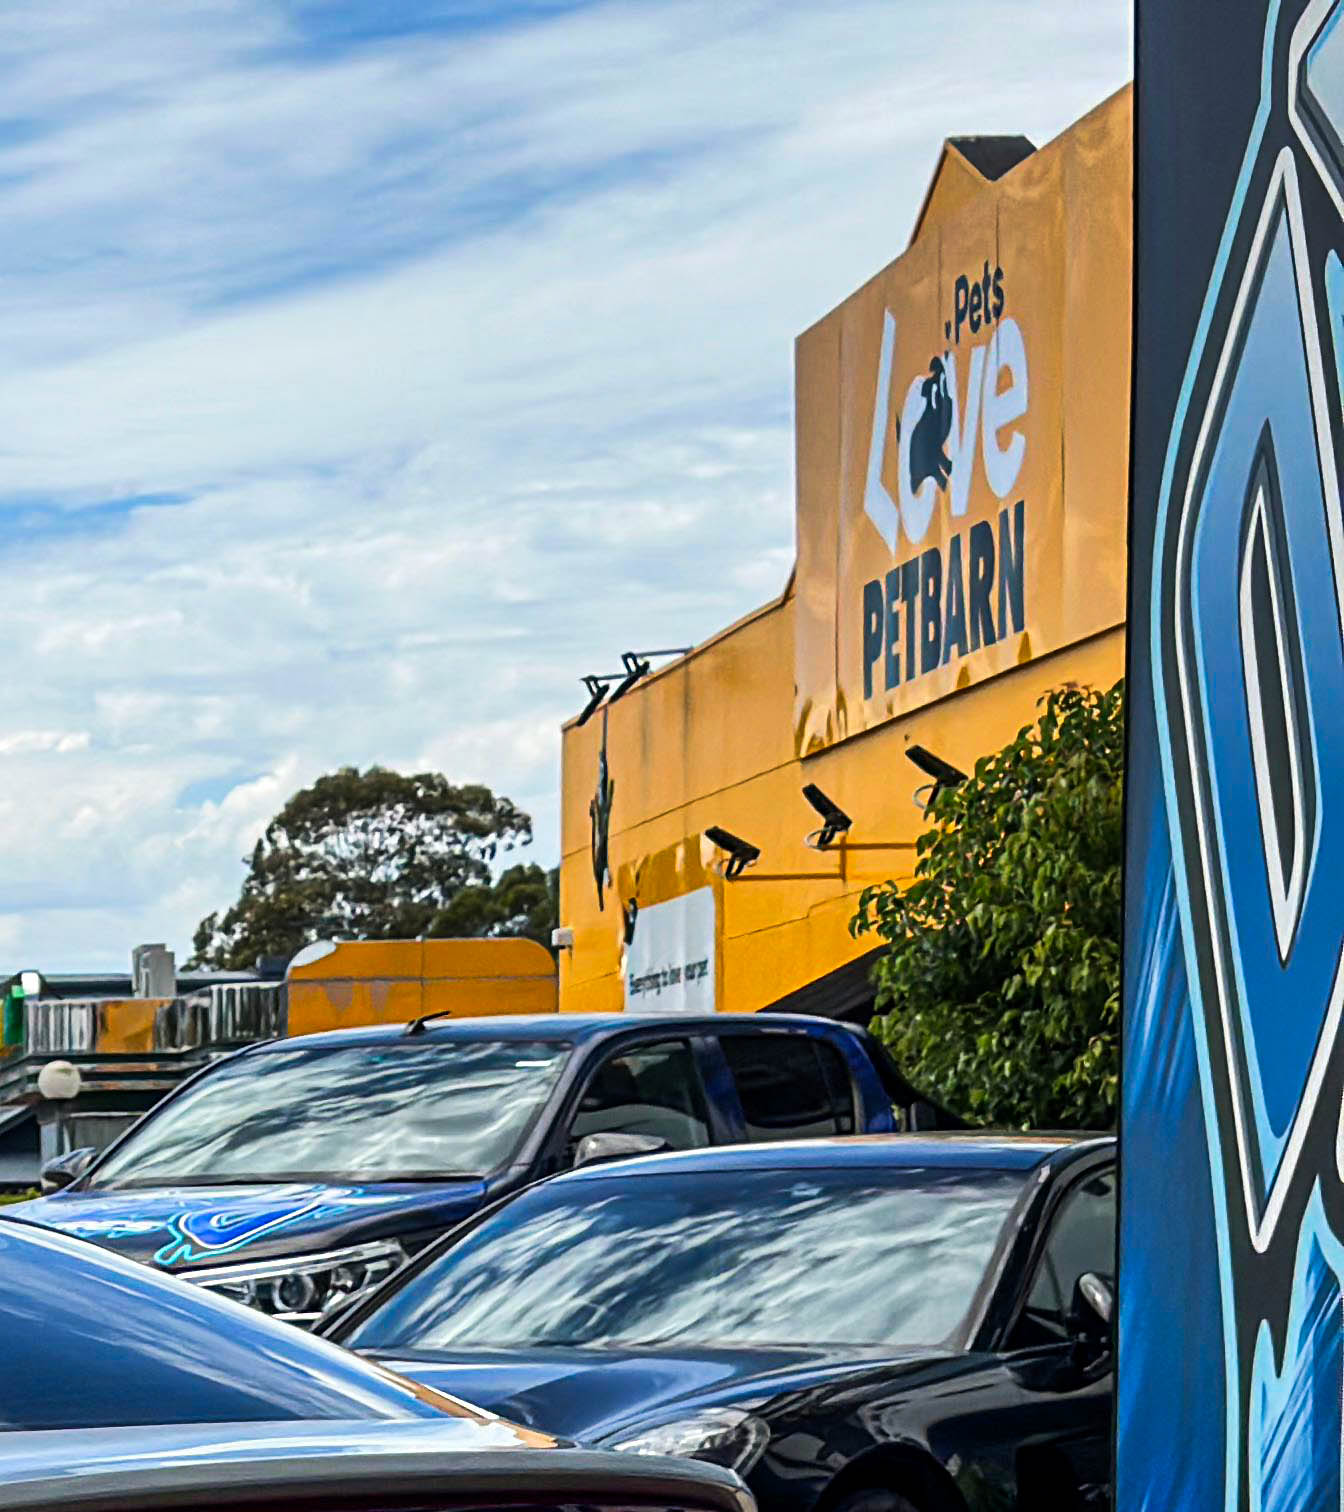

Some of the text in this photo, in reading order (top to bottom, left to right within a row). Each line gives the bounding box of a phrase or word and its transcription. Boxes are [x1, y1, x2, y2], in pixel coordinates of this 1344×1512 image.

[954, 259, 1005, 344] Pets
[864, 307, 1029, 558] Love
[863, 499, 1026, 701] PETBARN
